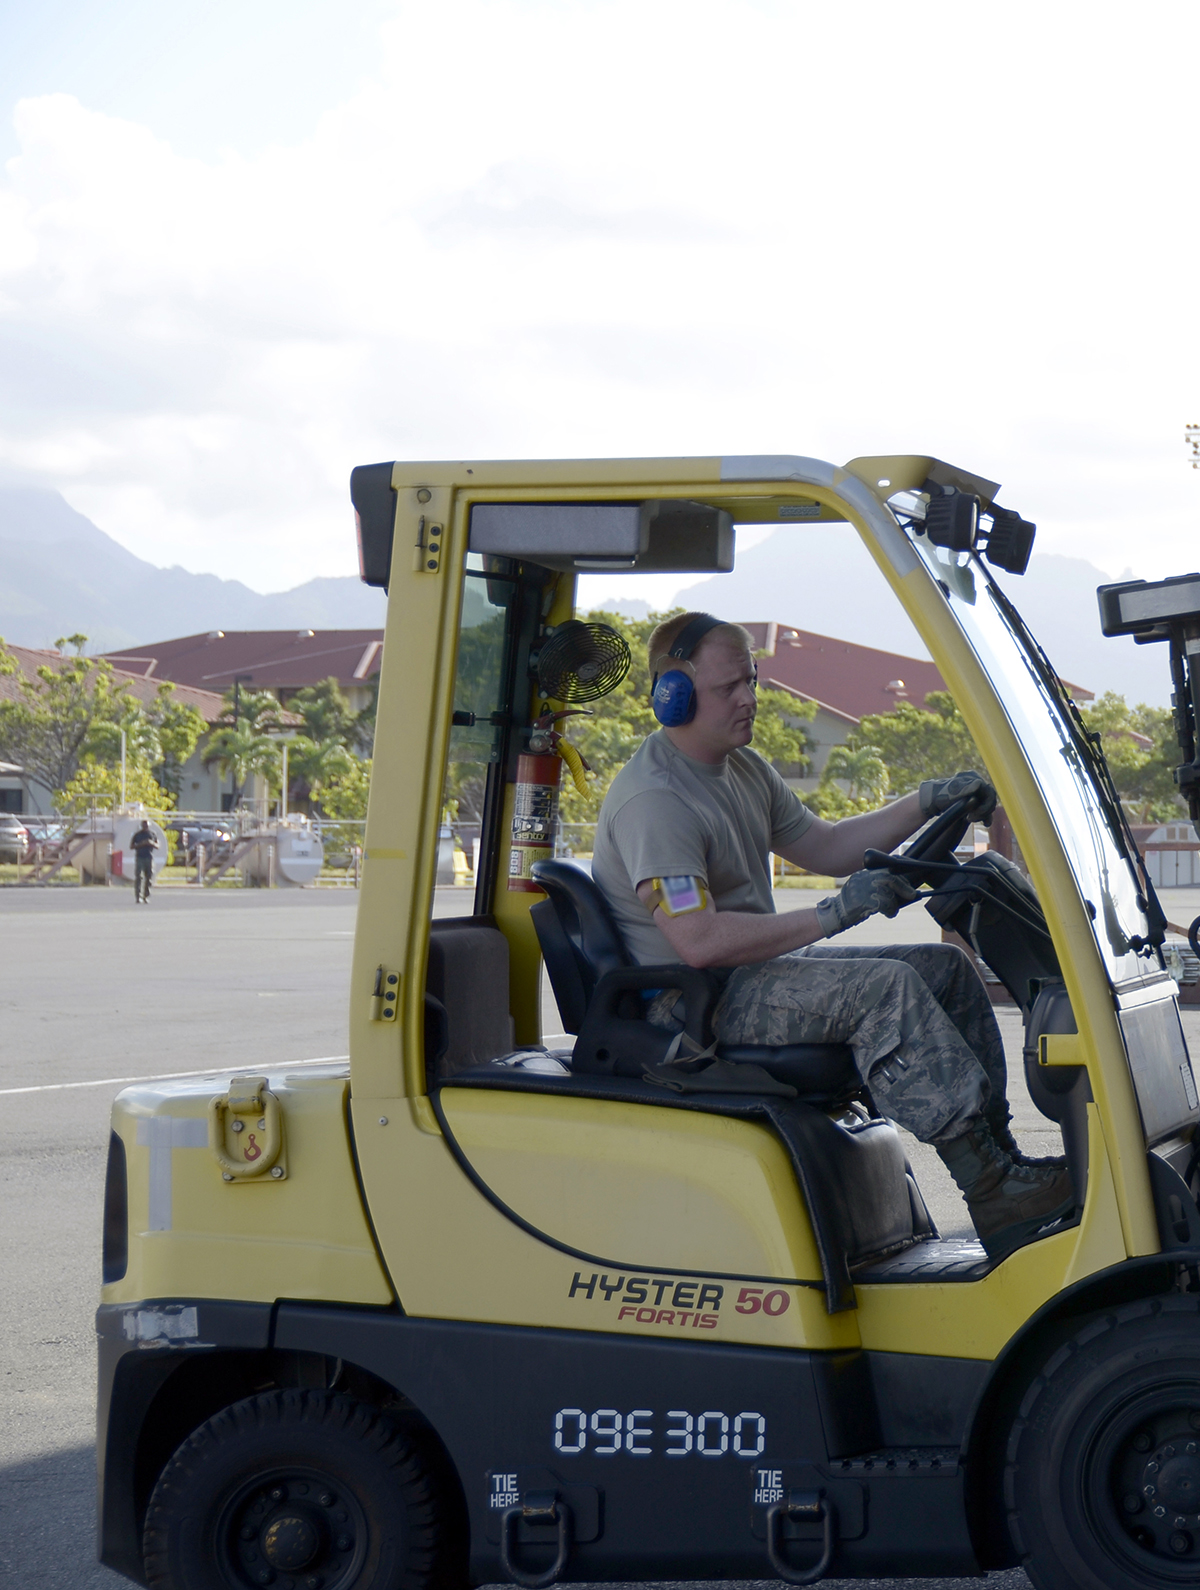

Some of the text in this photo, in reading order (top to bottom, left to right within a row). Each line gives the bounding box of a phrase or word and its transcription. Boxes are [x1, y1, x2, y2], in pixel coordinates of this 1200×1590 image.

[568, 1271, 791, 1317] HYSTER 50
[617, 1306, 720, 1329] FORTIS
[554, 1408, 766, 1457] 09E 300
[491, 1473, 518, 1492] TIE
[757, 1469, 783, 1488] TIE
